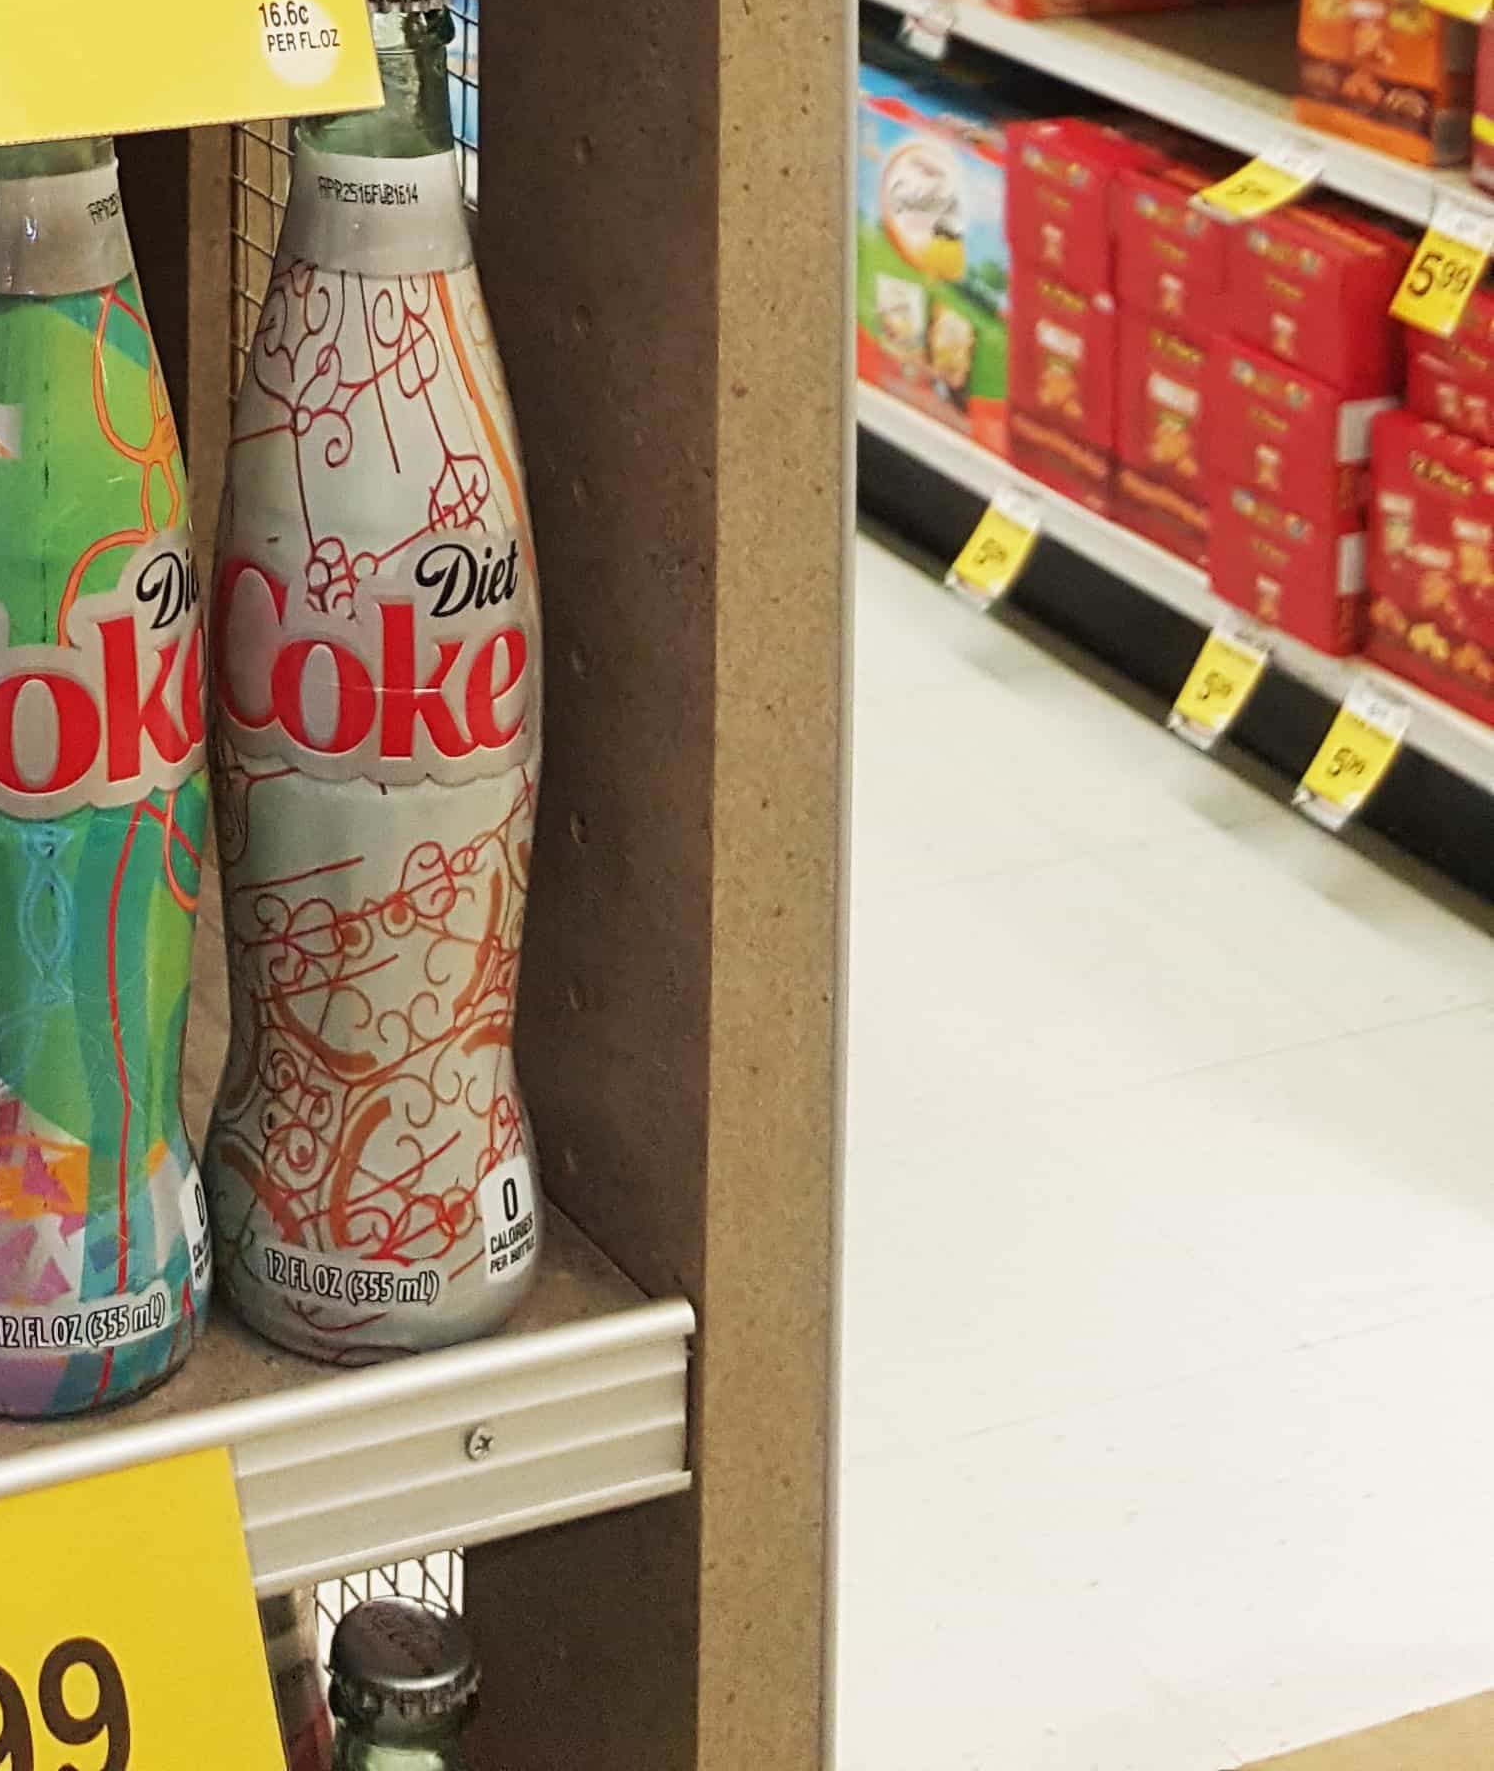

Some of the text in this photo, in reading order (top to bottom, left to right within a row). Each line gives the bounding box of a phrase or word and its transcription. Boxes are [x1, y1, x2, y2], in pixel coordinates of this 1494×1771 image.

[267, 31, 297, 53] PER
[415, 544, 519, 618] Diet
[222, 556, 527, 758] Coke
[502, 1177, 518, 1221] 0
[265, 1247, 439, 1305] 12 FL OZ (355 mL)
[490, 1256, 507, 1274] PER
[23, 1316, 49, 1348] FL
[51, 1314, 83, 1346] OZ
[86, 1306, 129, 1347] (355
[132, 1292, 166, 1332] mL)
